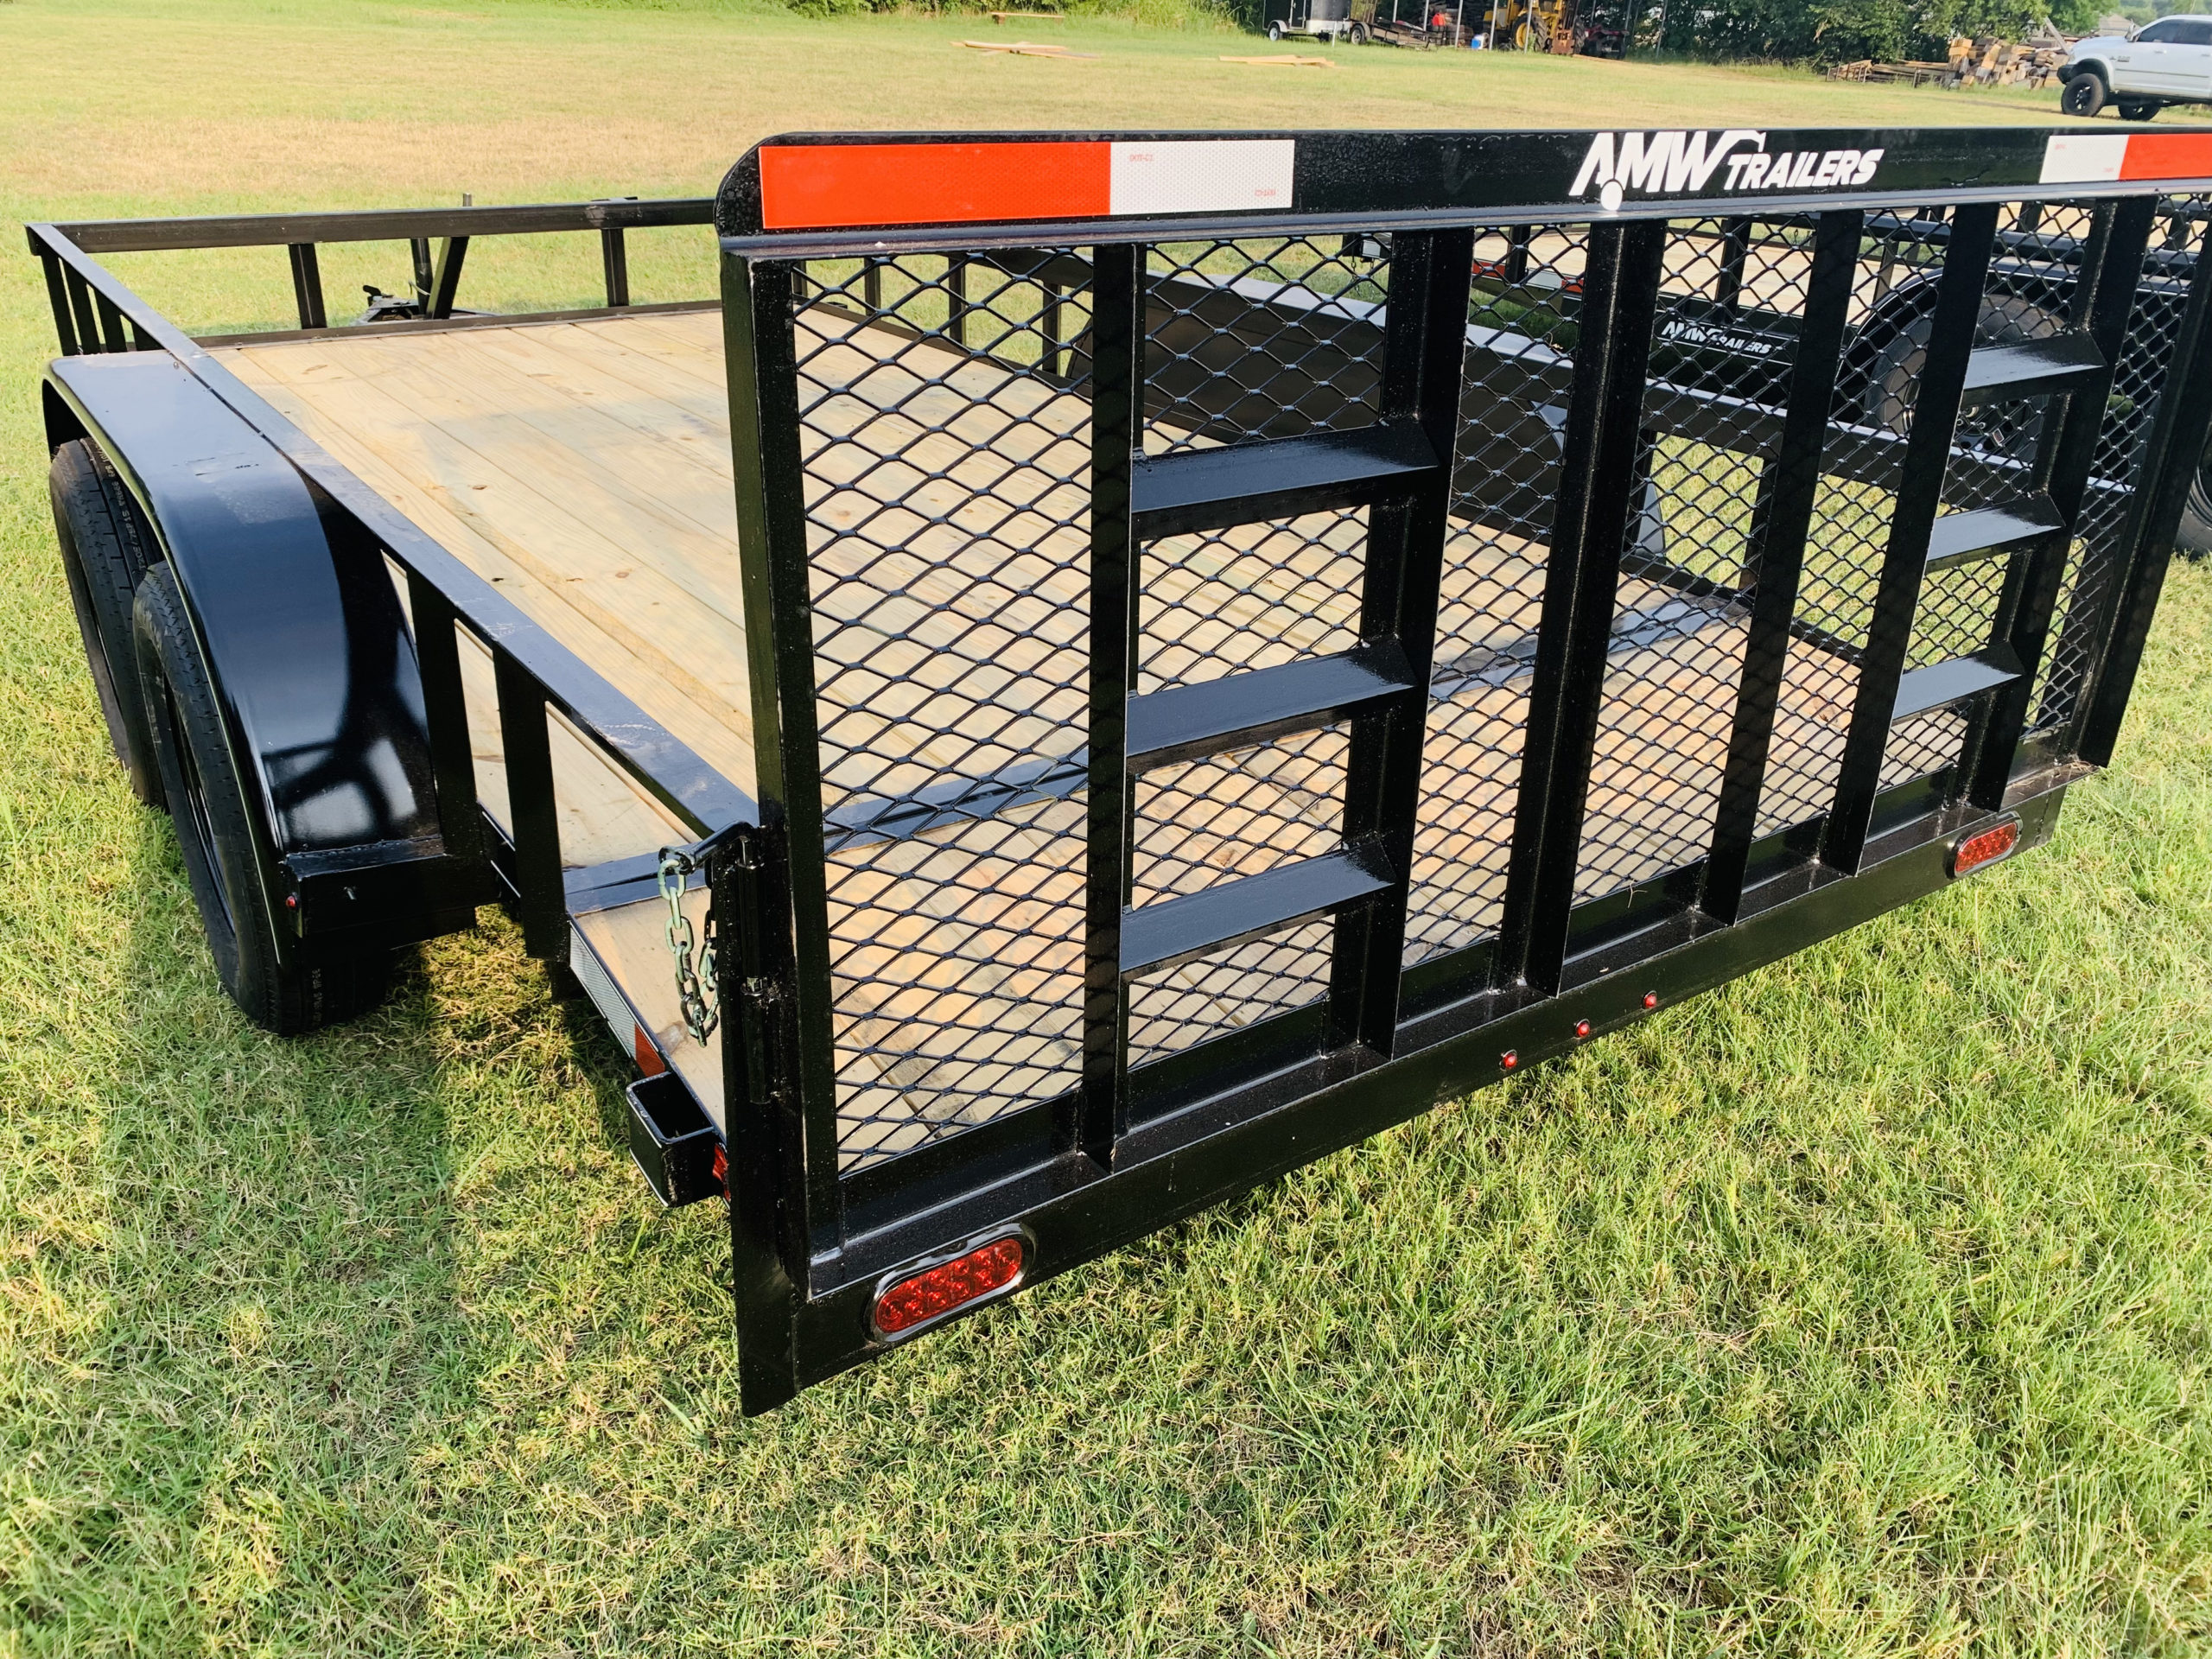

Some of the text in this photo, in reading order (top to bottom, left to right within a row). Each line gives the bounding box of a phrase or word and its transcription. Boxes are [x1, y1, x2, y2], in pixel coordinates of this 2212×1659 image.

[1568, 130, 1884, 197] AMW TRAILERS
[1662, 321, 1772, 353] AMW RAILERS
